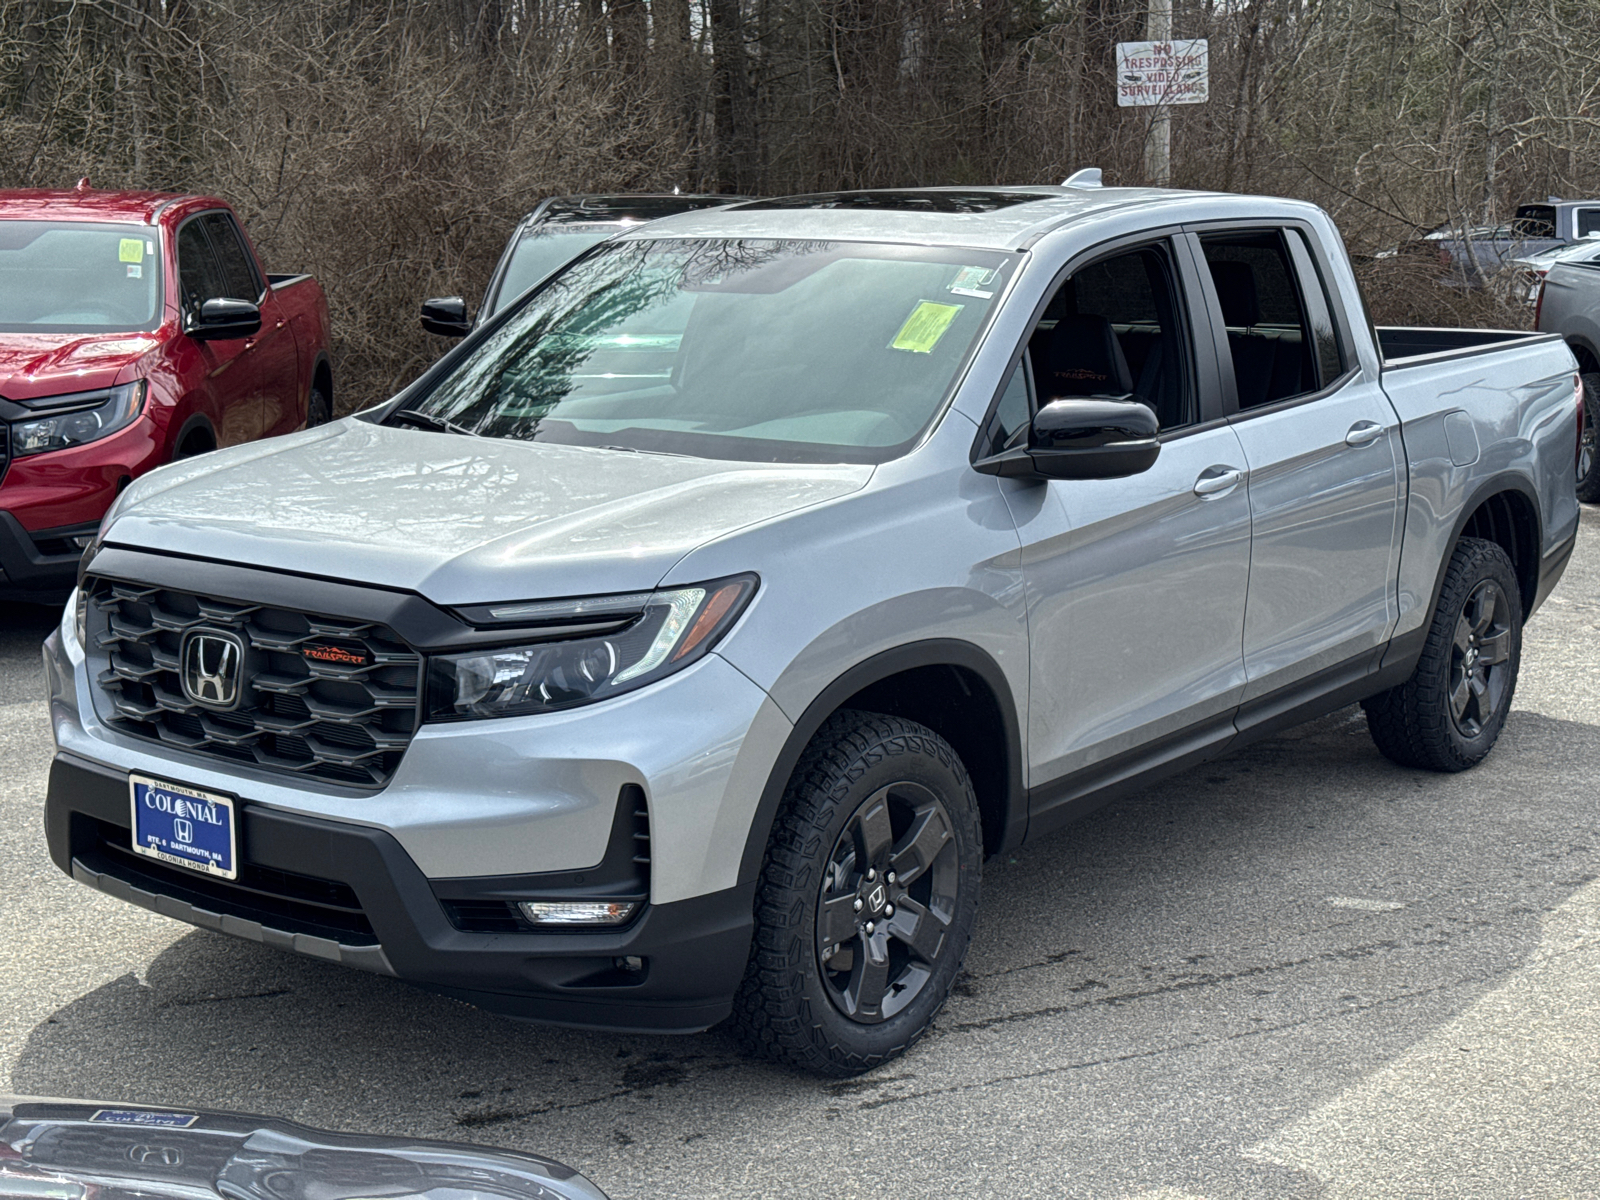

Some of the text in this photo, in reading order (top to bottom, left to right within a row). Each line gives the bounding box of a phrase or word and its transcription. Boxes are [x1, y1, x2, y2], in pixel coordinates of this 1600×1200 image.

[1153, 44, 1172, 55] NO
[1146, 72, 1180, 83] VIDEO
[303, 648, 365, 664] TRAILSPORT
[145, 791, 222, 826] COLONIAL
[157, 852, 210, 872] COLONIAL HONDA
